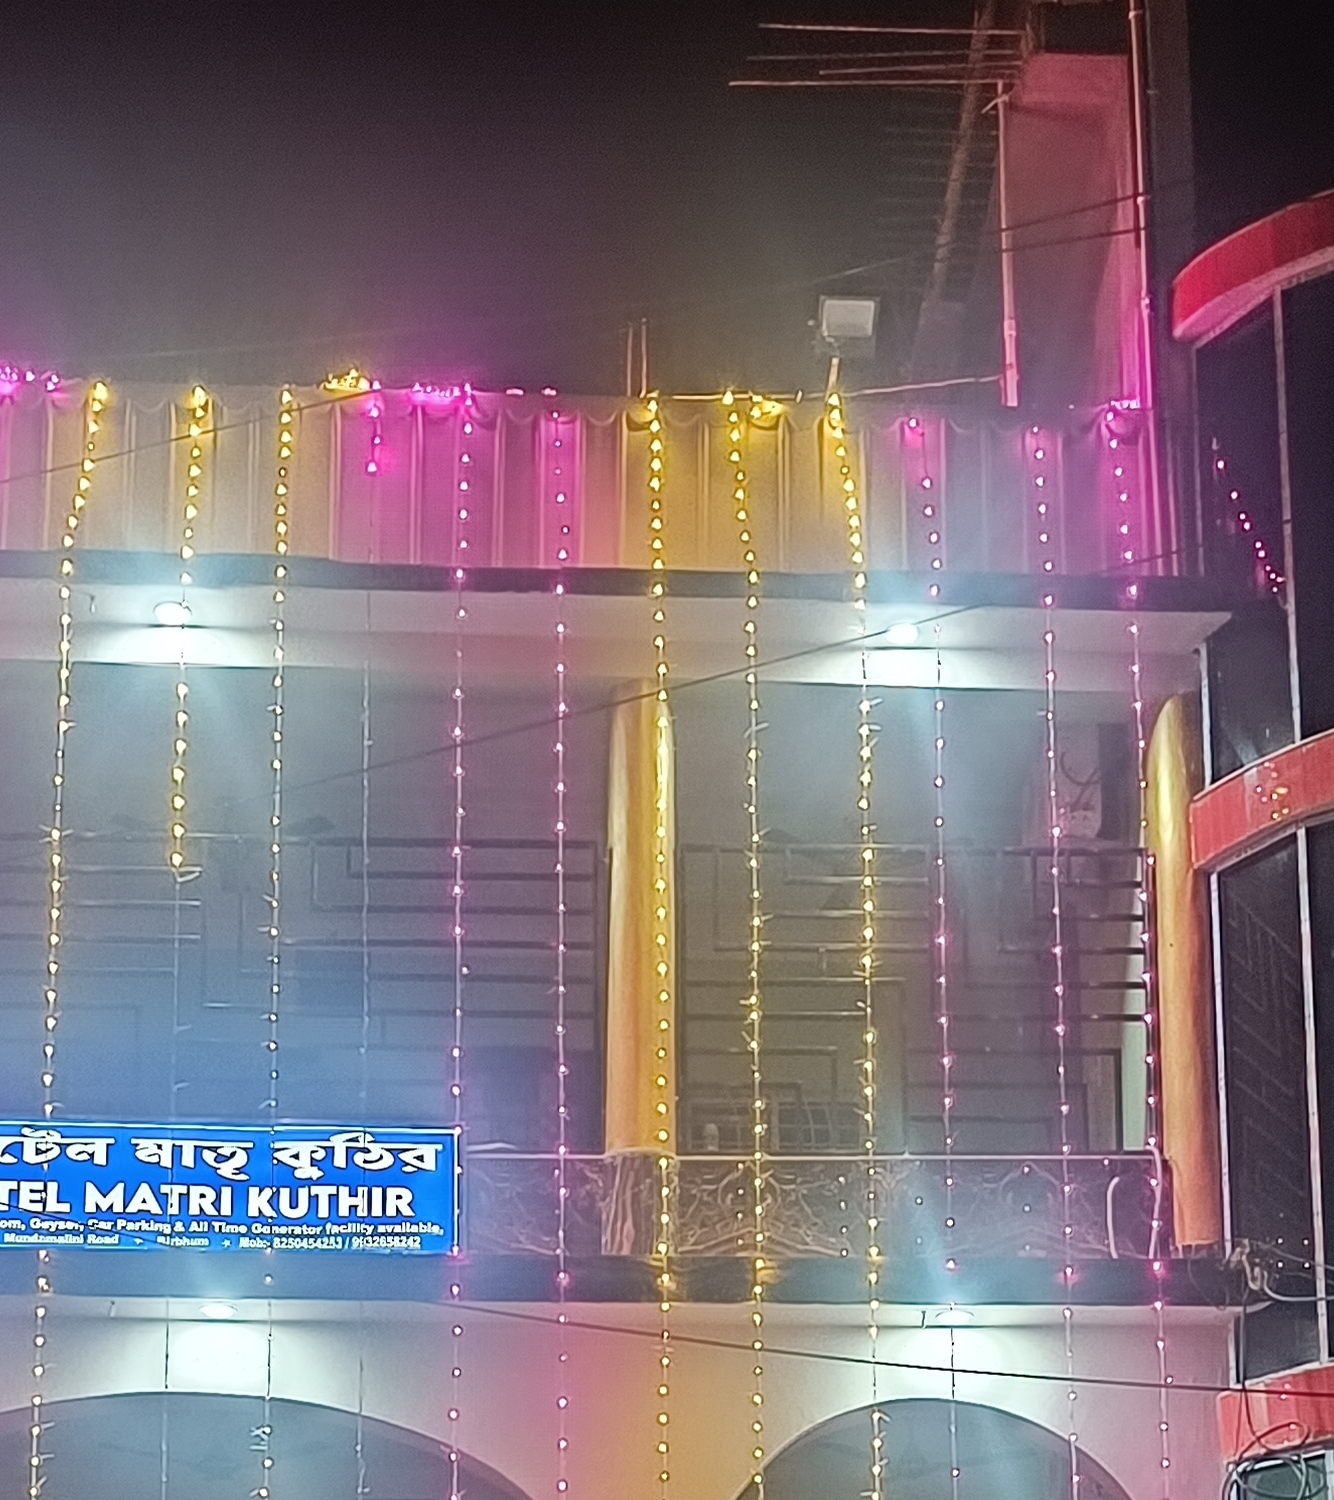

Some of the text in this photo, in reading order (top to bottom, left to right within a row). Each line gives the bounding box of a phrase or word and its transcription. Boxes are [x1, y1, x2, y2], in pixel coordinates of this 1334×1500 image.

[131, 1138, 254, 1181] মাতৃ
[273, 1131, 443, 1180] কুঠির
[85, 1182, 232, 1217] MATRI
[248, 1186, 416, 1219] KUTHIR
[87, 1219, 114, 1231] Car
[116, 1219, 171, 1234] Parking
[173, 1221, 186, 1232] &
[189, 1221, 208, 1232] All
[212, 1221, 248, 1233] Time
[251, 1223, 323, 1235] Generator
[325, 1222, 374, 1235] facility
[87, 1234, 119, 1244] Road
